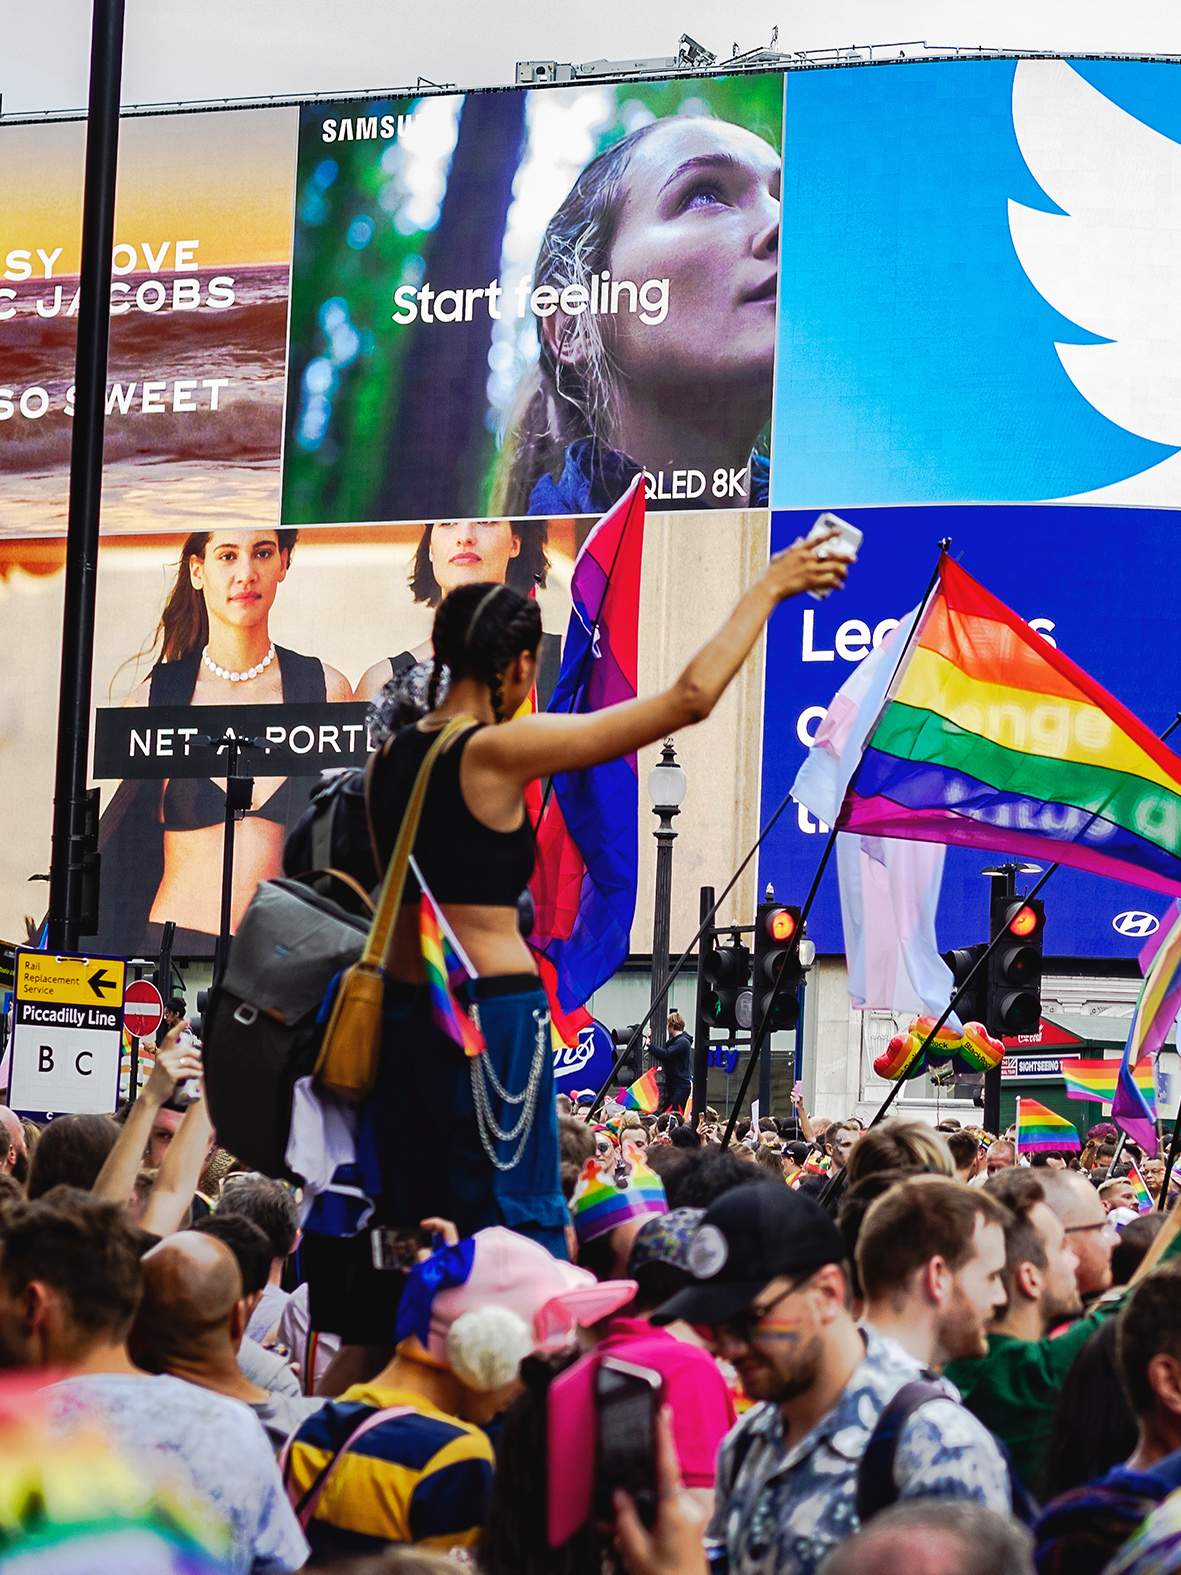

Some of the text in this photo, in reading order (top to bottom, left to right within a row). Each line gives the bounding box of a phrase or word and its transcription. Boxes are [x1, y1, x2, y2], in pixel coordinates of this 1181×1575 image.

[112, 240, 200, 275] OVE
[391, 270, 671, 326] Start feeling
[711, 467, 748, 498] 8K
[24, 961, 41, 971] Rail
[23, 984, 54, 994] Service
[24, 973, 80, 985] Replacement
[22, 1005, 116, 1027] Piccadilly Line
[38, 1045, 93, 1076] B C
[1018, 1060, 1060, 1073] SIGHTSEEING
